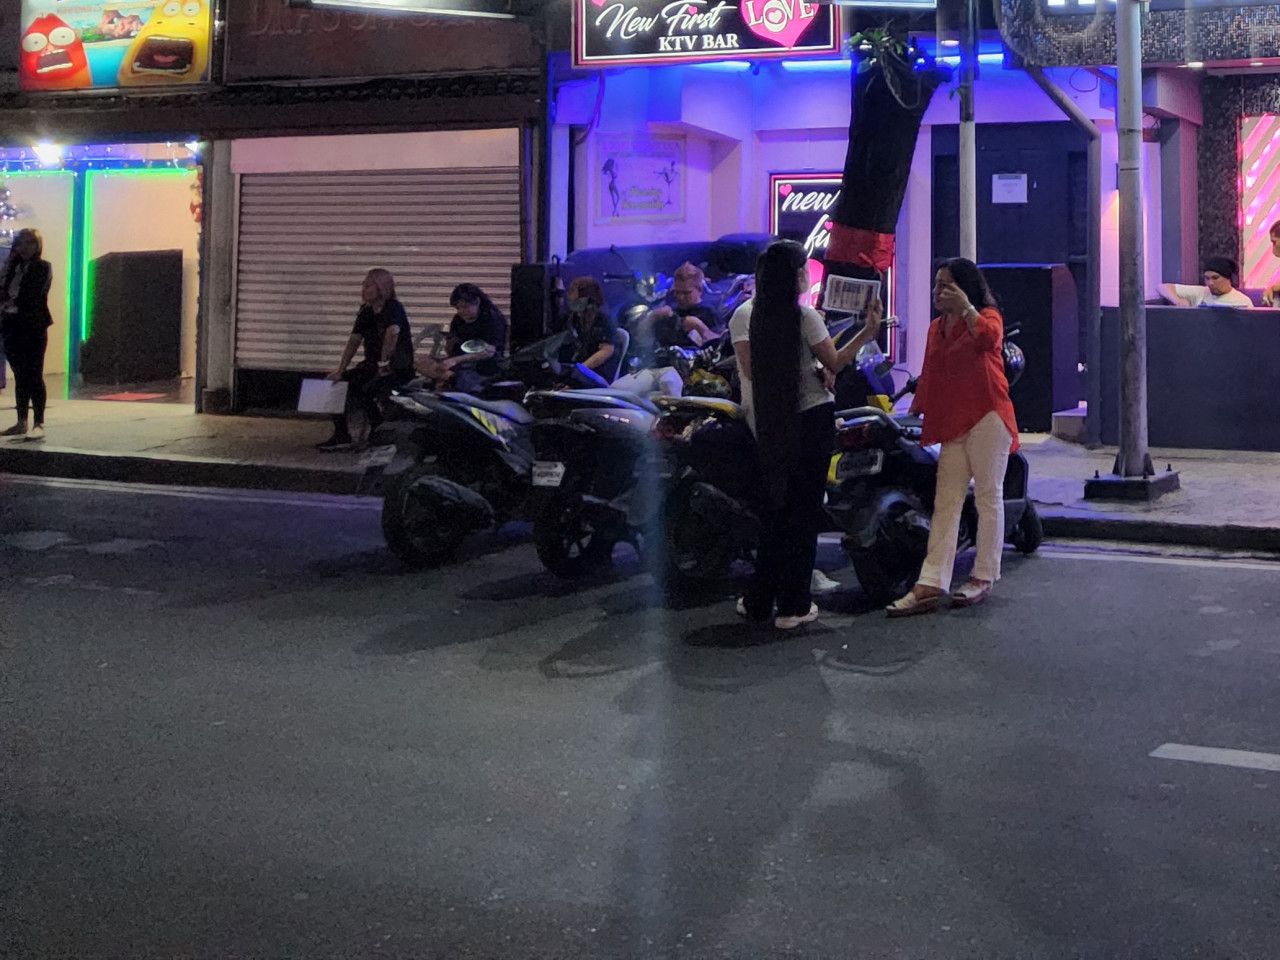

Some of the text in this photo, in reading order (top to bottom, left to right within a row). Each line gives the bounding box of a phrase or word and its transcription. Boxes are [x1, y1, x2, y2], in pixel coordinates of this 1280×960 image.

[596, 0, 738, 39] New First
[658, 33, 739, 52] KTV BAR
